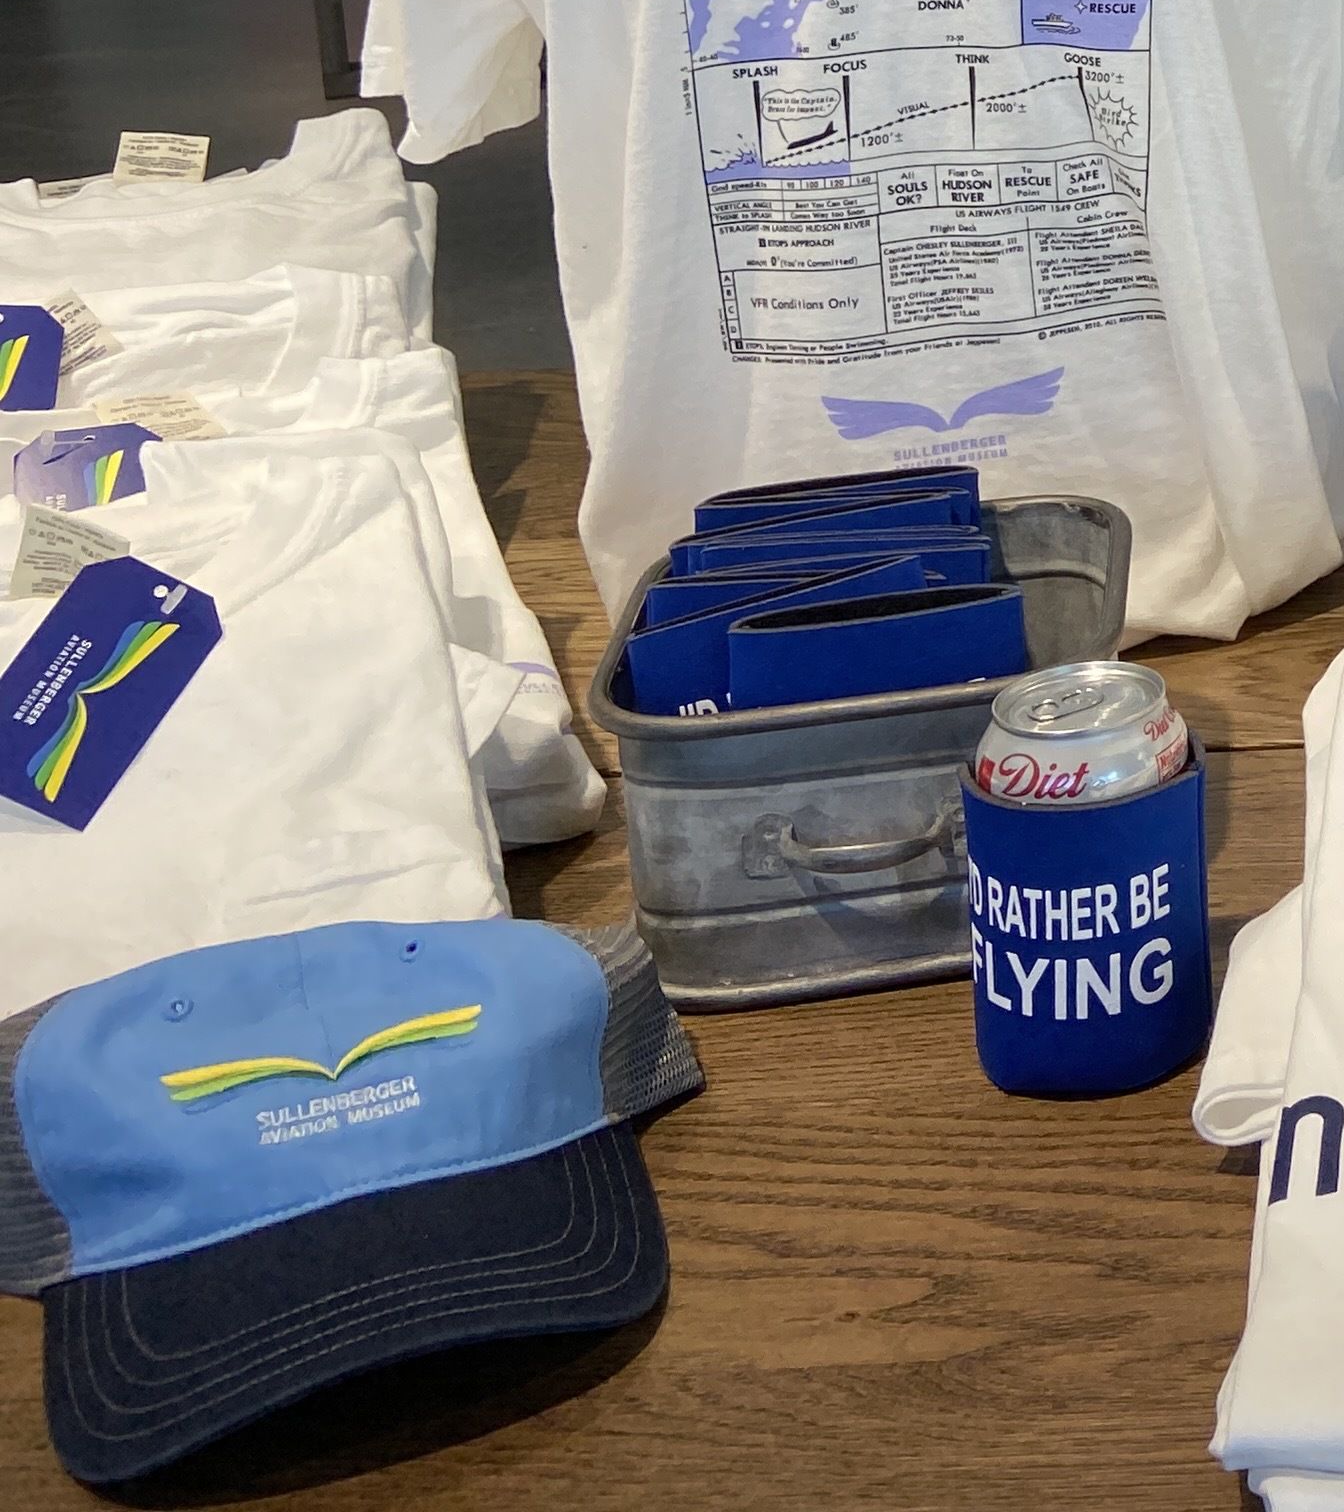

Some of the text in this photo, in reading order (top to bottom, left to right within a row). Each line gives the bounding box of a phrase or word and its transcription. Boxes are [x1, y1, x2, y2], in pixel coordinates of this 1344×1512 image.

[918, 0, 964, 11] DONNA
[1089, 3, 1136, 13] RESCUE
[956, 54, 990, 64] THINK
[1064, 52, 1101, 67] GOOSE
[732, 66, 778, 79] SPLASH
[823, 59, 867, 74] FOCUS
[1005, 177, 1052, 187] RESCUE
[1069, 170, 1099, 184] SAFE
[887, 181, 928, 195] SOULS
[942, 179, 992, 190] HUDSON
[896, 195, 922, 206] OK?
[951, 192, 985, 203] RIVER
[828, 297, 859, 309] Only
[894, 435, 1007, 461] SULLENBERGER
[12, 634, 80, 721] AVIATION MUSEUM
[24, 639, 93, 726] SULLENBERGER
[999, 753, 1090, 800] Diet
[987, 863, 1171, 941] RATHER BE
[971, 922, 1175, 1021] FLYING
[256, 1076, 417, 1130] SULLENBERGER
[259, 1092, 420, 1145] AVIATION MUSEUM
